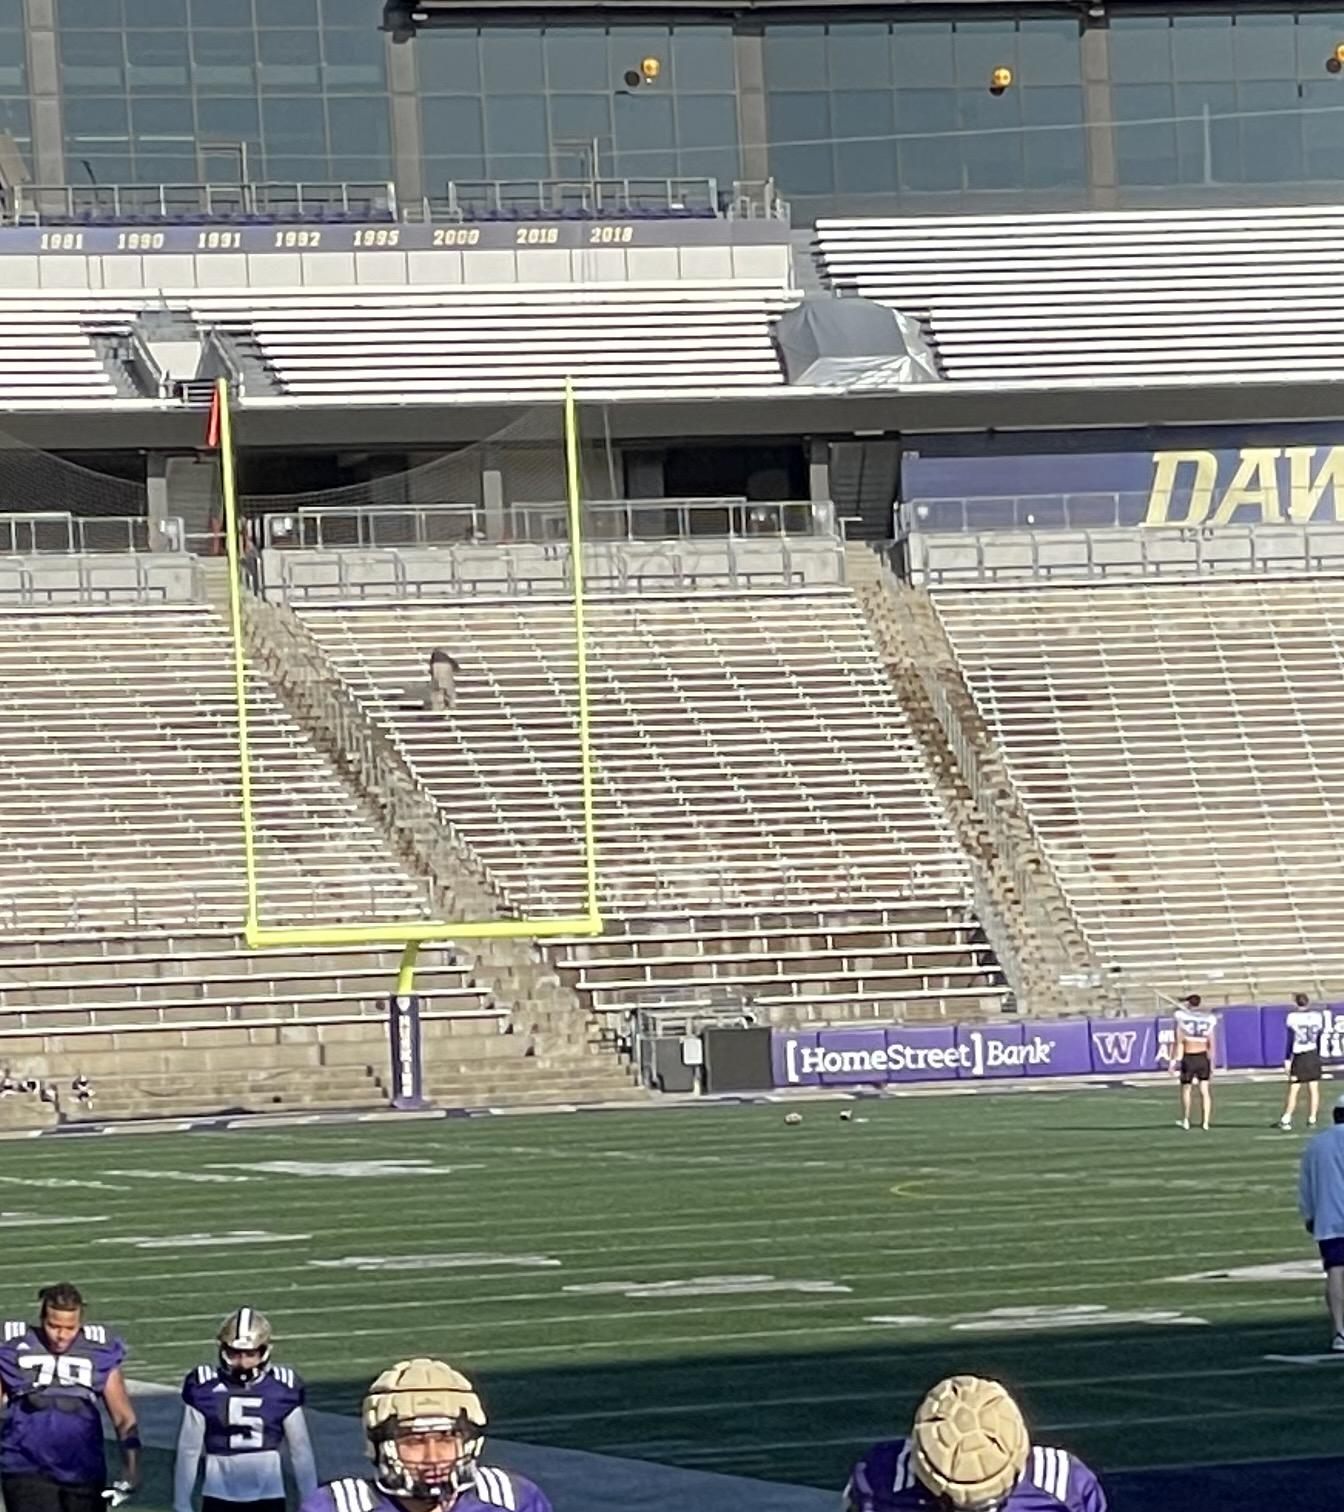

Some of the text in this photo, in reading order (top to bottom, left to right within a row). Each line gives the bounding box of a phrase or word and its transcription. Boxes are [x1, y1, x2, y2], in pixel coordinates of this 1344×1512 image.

[197, 232, 241, 249] 1991
[274, 231, 321, 248] 1992
[353, 229, 400, 247] 1995
[432, 229, 480, 246] 2000
[987, 1036, 1052, 1066] Bank
[229, 1398, 264, 1448] 5
